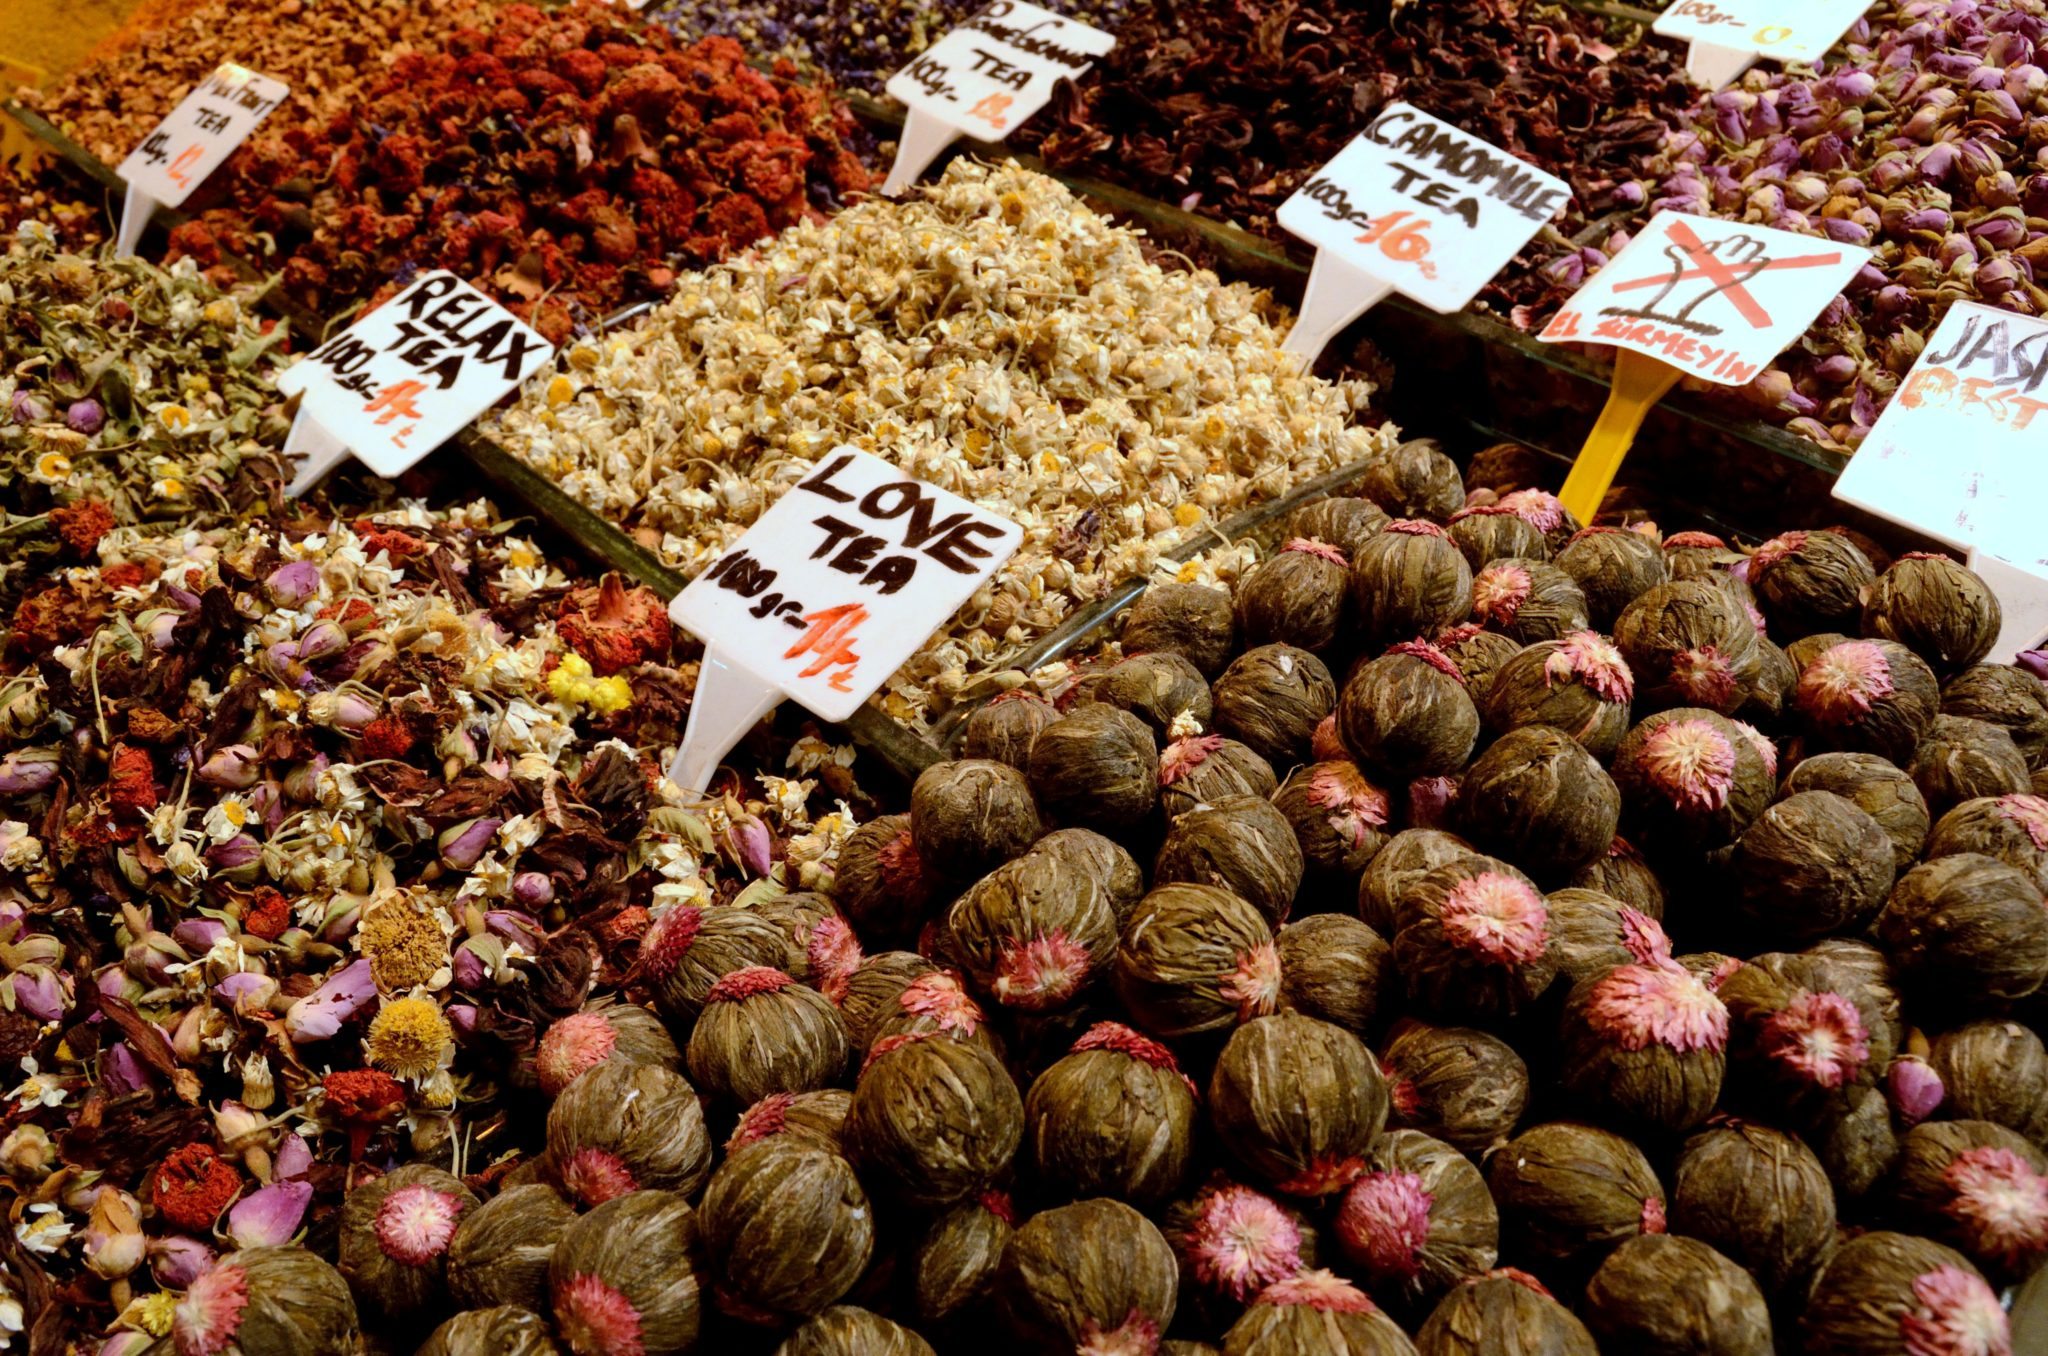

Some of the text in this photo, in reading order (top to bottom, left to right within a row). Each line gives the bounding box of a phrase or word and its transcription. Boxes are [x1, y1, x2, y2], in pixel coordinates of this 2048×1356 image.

[970, 48, 1033, 91] TEA
[194, 106, 231, 135] TEA
[1386, 162, 1479, 229] TEA
[1354, 211, 1432, 262] 16
[384, 321, 464, 390] TEA
[396, 276, 549, 380] RELAX
[1543, 311, 1582, 337] EL
[363, 379, 429, 425] 14
[798, 455, 1007, 574] LOVE
[809, 515, 917, 595] TEA
[784, 604, 871, 677] 14
